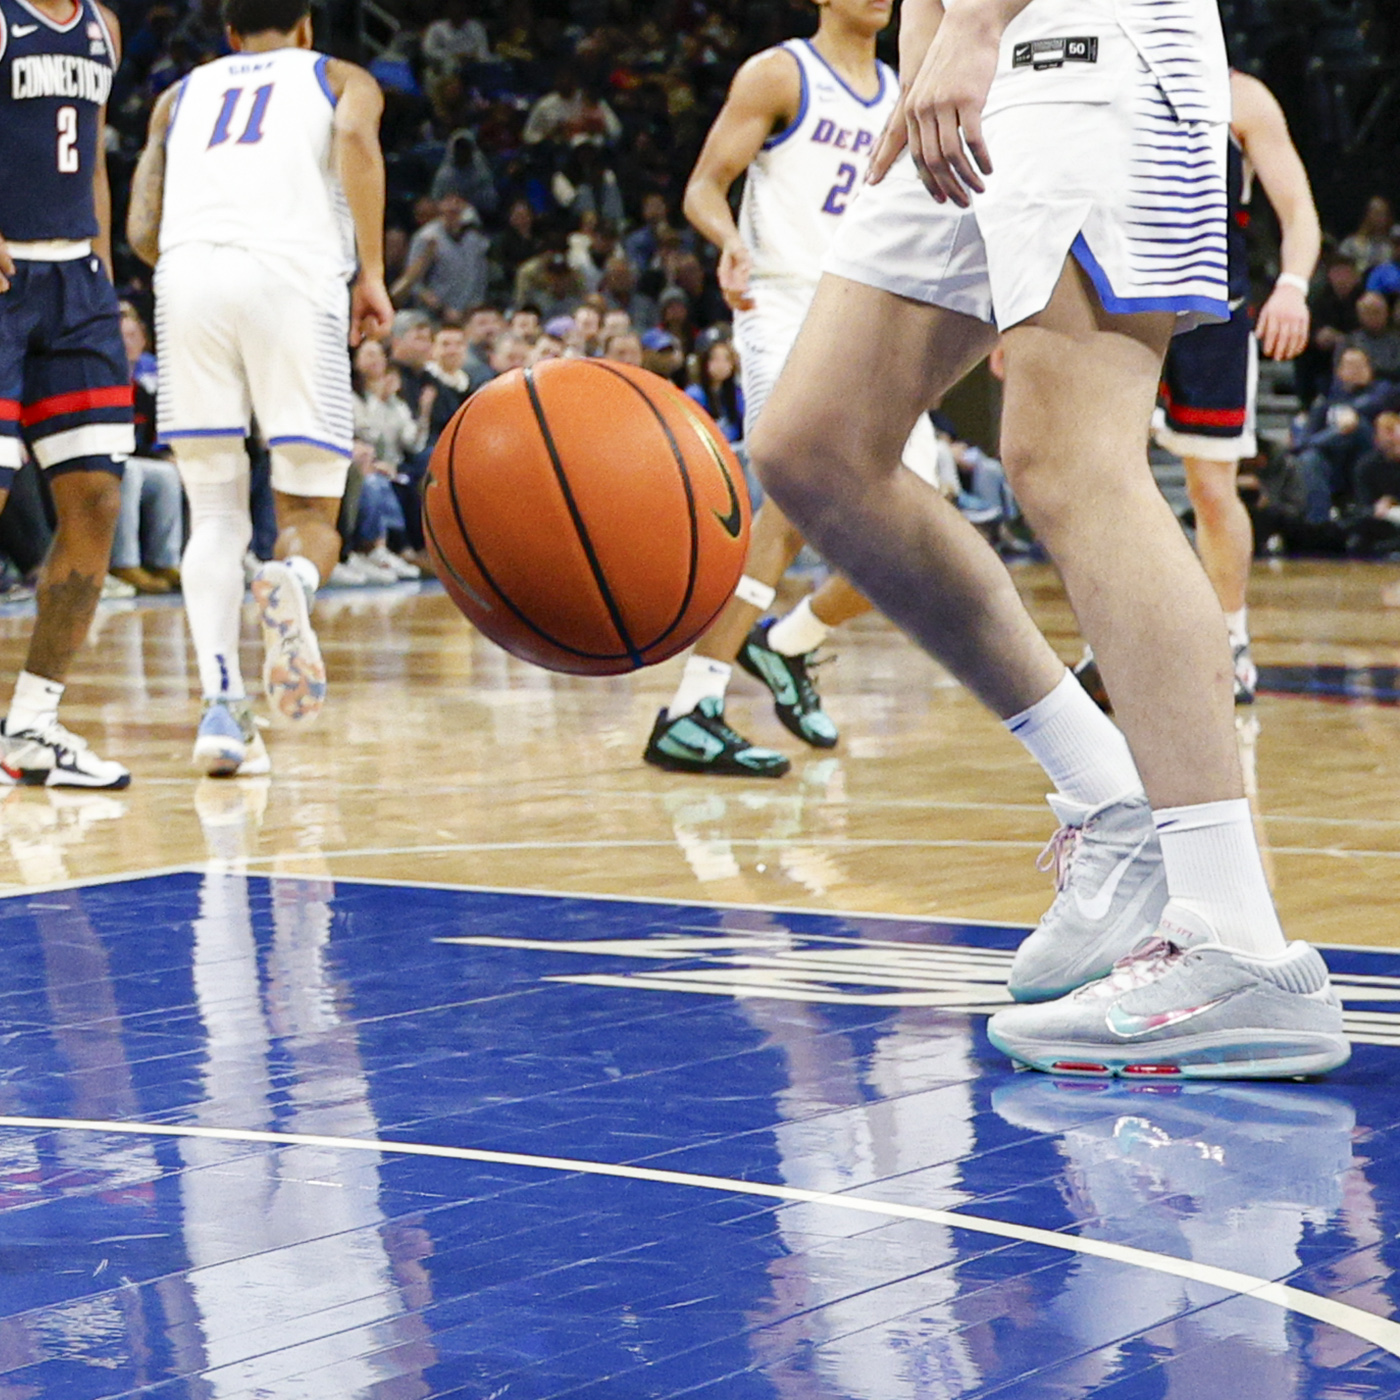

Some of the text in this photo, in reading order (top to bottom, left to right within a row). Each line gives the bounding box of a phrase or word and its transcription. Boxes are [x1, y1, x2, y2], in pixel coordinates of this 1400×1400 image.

[56, 105, 80, 174] 2
[205, 81, 276, 152] 11
[810, 116, 877, 157] DEP
